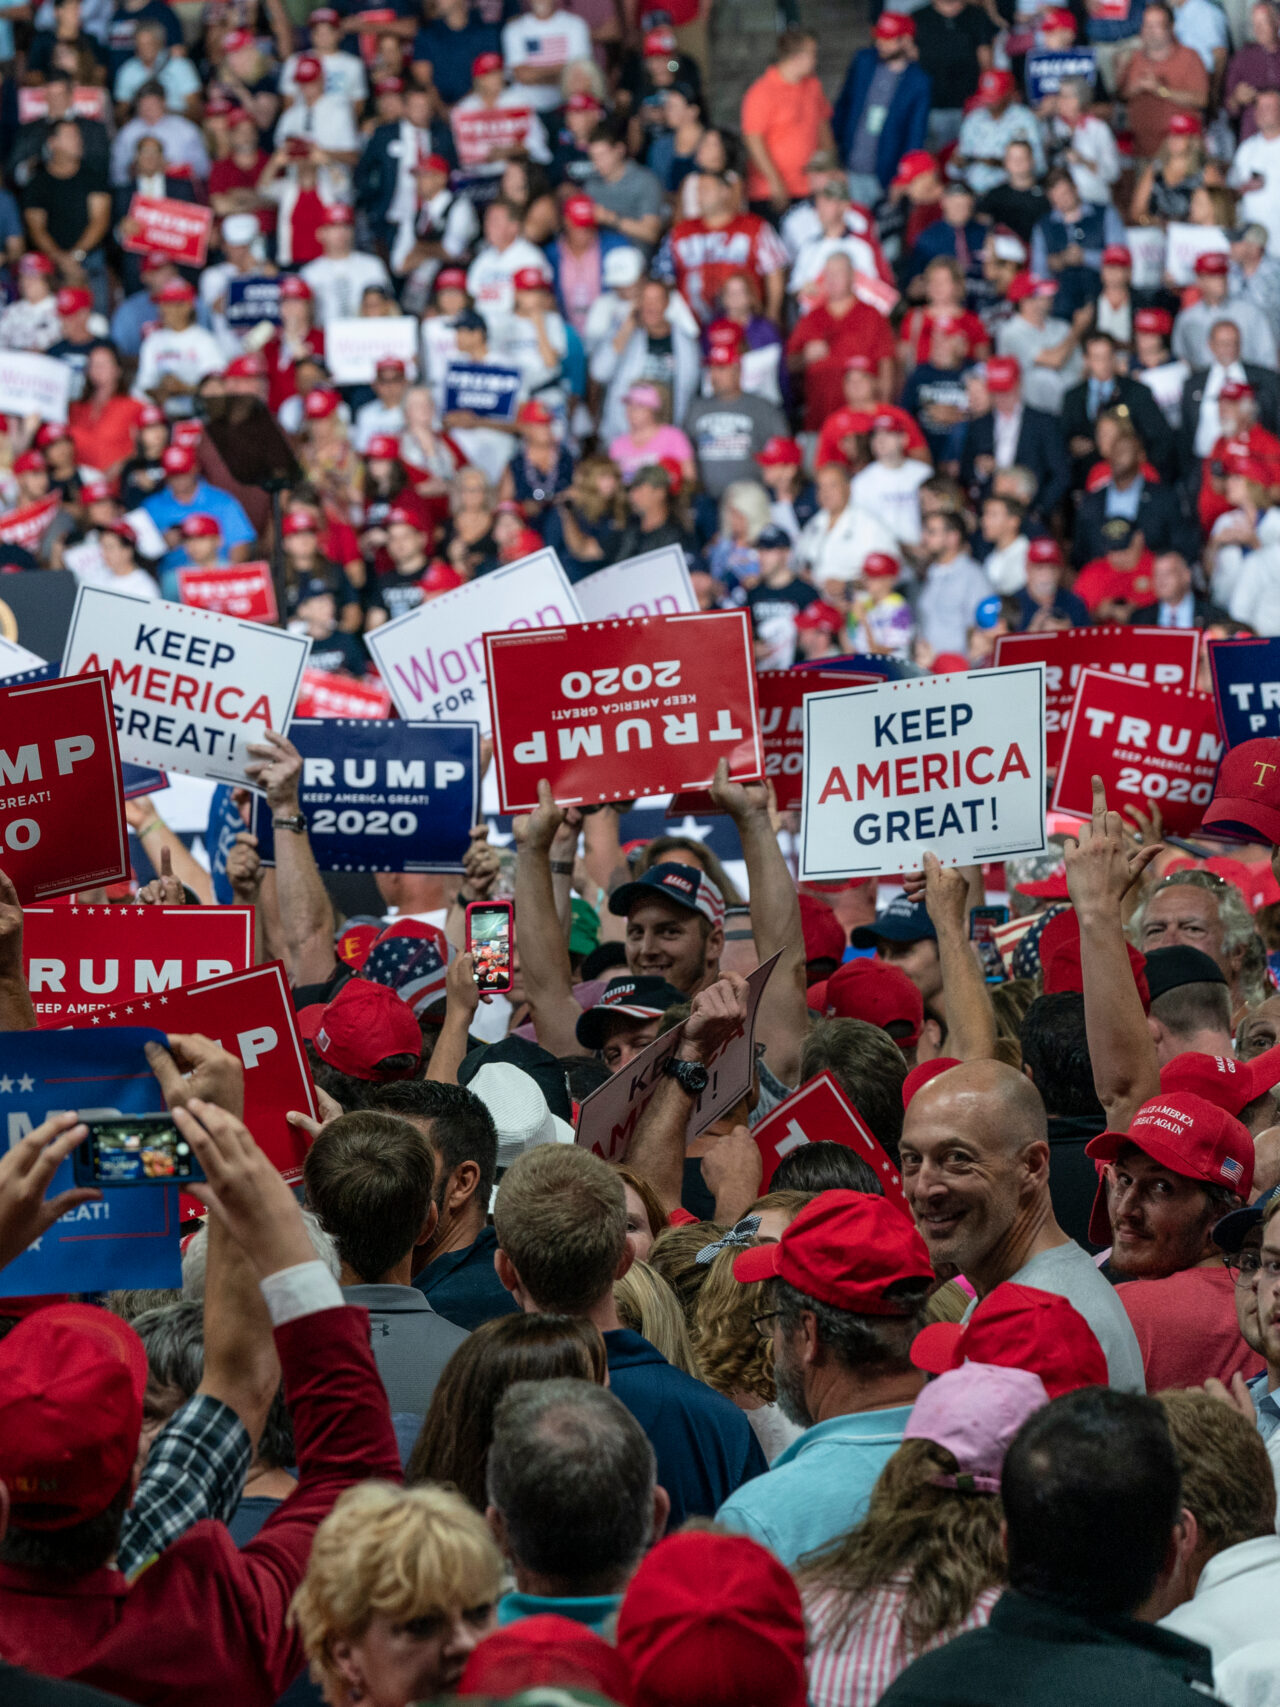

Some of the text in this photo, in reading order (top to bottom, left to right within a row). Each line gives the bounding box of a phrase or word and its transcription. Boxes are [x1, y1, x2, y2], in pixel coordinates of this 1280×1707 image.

[134, 623, 236, 670] KEEP
[77, 652, 274, 730] AMERICA
[561, 661, 681, 700] 2020
[432, 687, 476, 721] FOR
[551, 694, 696, 721] KEEP AMERICA GREAT!
[513, 709, 743, 765] TRUMP
[874, 703, 973, 747] KEEP
[1085, 707, 1223, 762] TRUM
[1112, 748, 1142, 763] KEEP
[303, 758, 466, 789] RUMP
[818, 742, 1031, 805] AMERICA
[1116, 767, 1213, 805] 2020
[302, 793, 429, 806] KEEP AMERICA GREAT!
[311, 810, 418, 836] 2020
[853, 797, 998, 846] GREAT!
[29, 958, 232, 994] RUMP
[33, 1002, 62, 1014] EEP
[1154, 1117, 1184, 1136] AGAIN
[1155, 1105, 1194, 1128] AMERICA
[53, 1202, 110, 1224] EAT!
